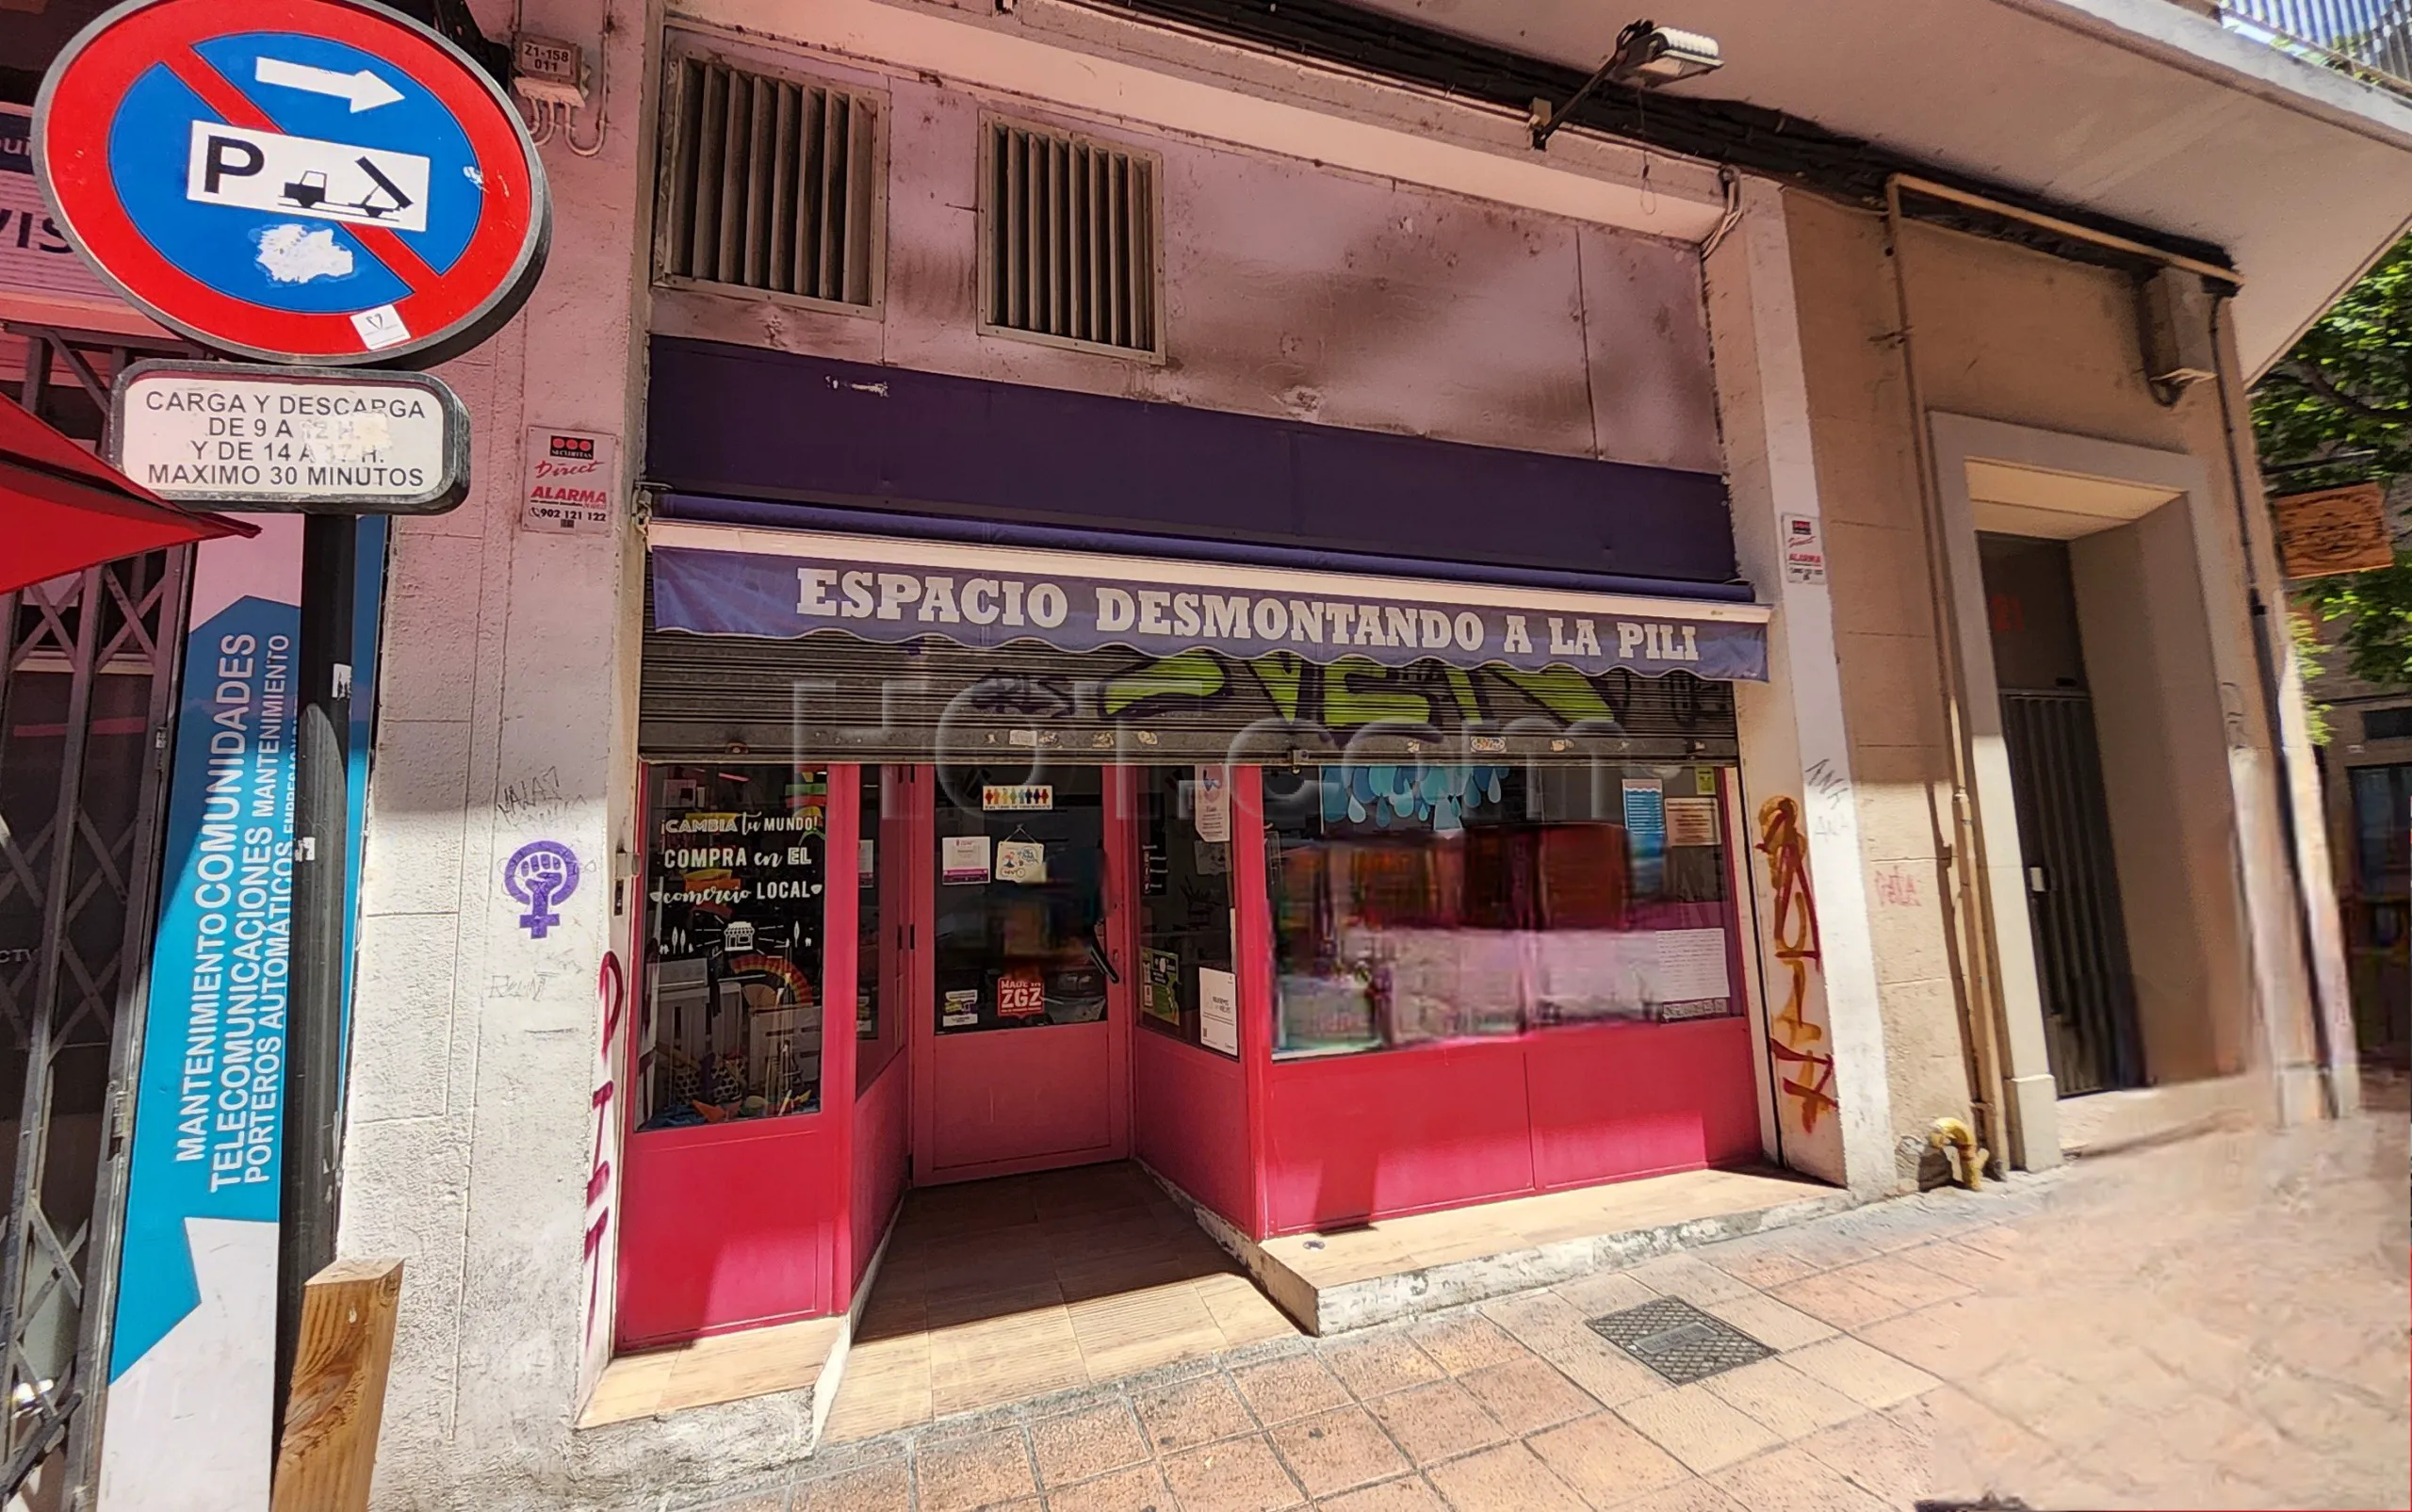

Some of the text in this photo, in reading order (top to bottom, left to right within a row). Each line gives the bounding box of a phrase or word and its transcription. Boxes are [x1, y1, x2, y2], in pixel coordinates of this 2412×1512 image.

[525, 44, 569, 62] Z1-158
[534, 58, 558, 72] 011
[204, 136, 265, 194] P
[146, 391, 425, 418] CARGA Y DESCARGA
[209, 418, 244, 437] DE
[254, 419, 267, 437] 9
[275, 420, 293, 438] A
[190, 440, 209, 460] Y
[219, 442, 253, 461] DE
[264, 442, 291, 462] 14
[300, 443, 316, 463] A
[148, 464, 424, 487] MAXIMO 30 MINUTOS
[534, 460, 605, 479] Direct
[530, 486, 608, 504] ALARMA
[540, 509, 607, 522] 902 121 122
[796, 568, 1699, 660] ESPACIO DESMONTANDO A LA PILI
[737, 811, 761, 836] tu
[764, 817, 818, 831] MUNDO!
[664, 847, 812, 868] COMPRA en EL
[175, 634, 255, 1162] MANTENIMIENTO COMUNIDADES
[660, 881, 810, 904] comercio LOCAL
[210, 635, 288, 1193] TELECOMUNICACIONES MANTENIMIENTO
[259, 840, 293, 1030] AUTOMATICOS
[1002, 987, 1042, 1008] ZGZ
[244, 1037, 281, 1184] PORTEROS
